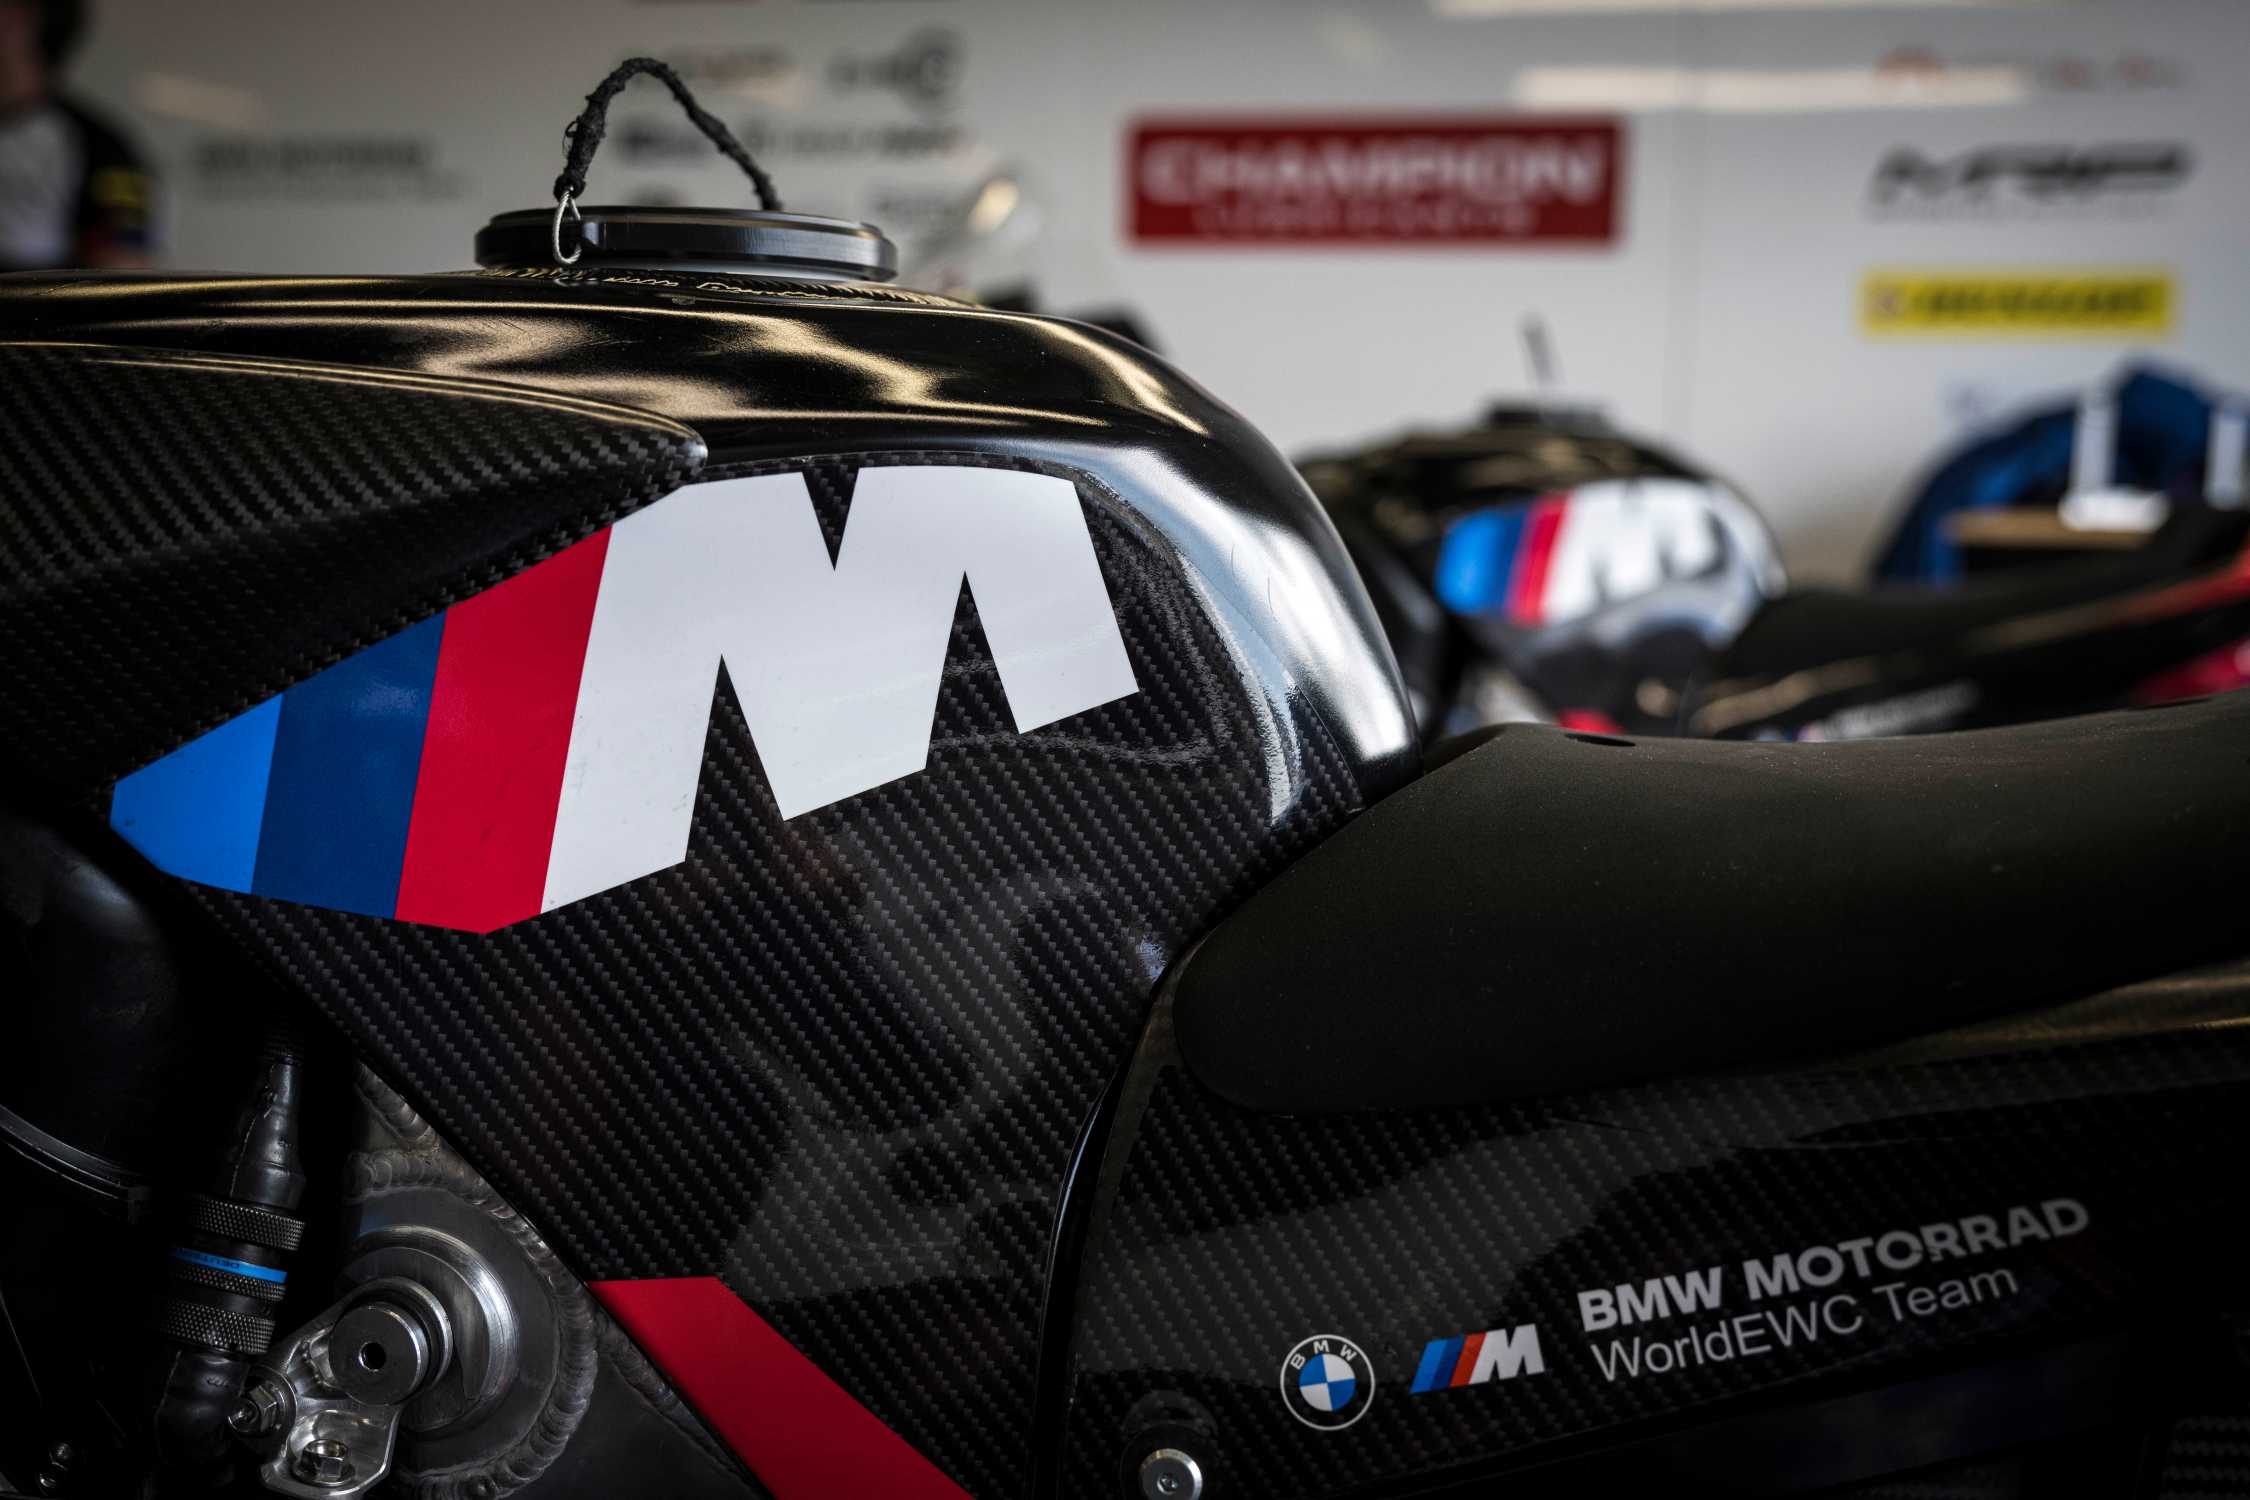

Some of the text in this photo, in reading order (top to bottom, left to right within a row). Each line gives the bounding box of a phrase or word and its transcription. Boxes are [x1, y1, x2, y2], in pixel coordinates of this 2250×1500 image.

[1144, 138, 1601, 203] CHAMPION
[1577, 1199, 2089, 1333] BMW MOTORRAD
[1290, 1340, 1357, 1370] BMW
[1590, 1268, 2018, 1382] WorldEWC Team
